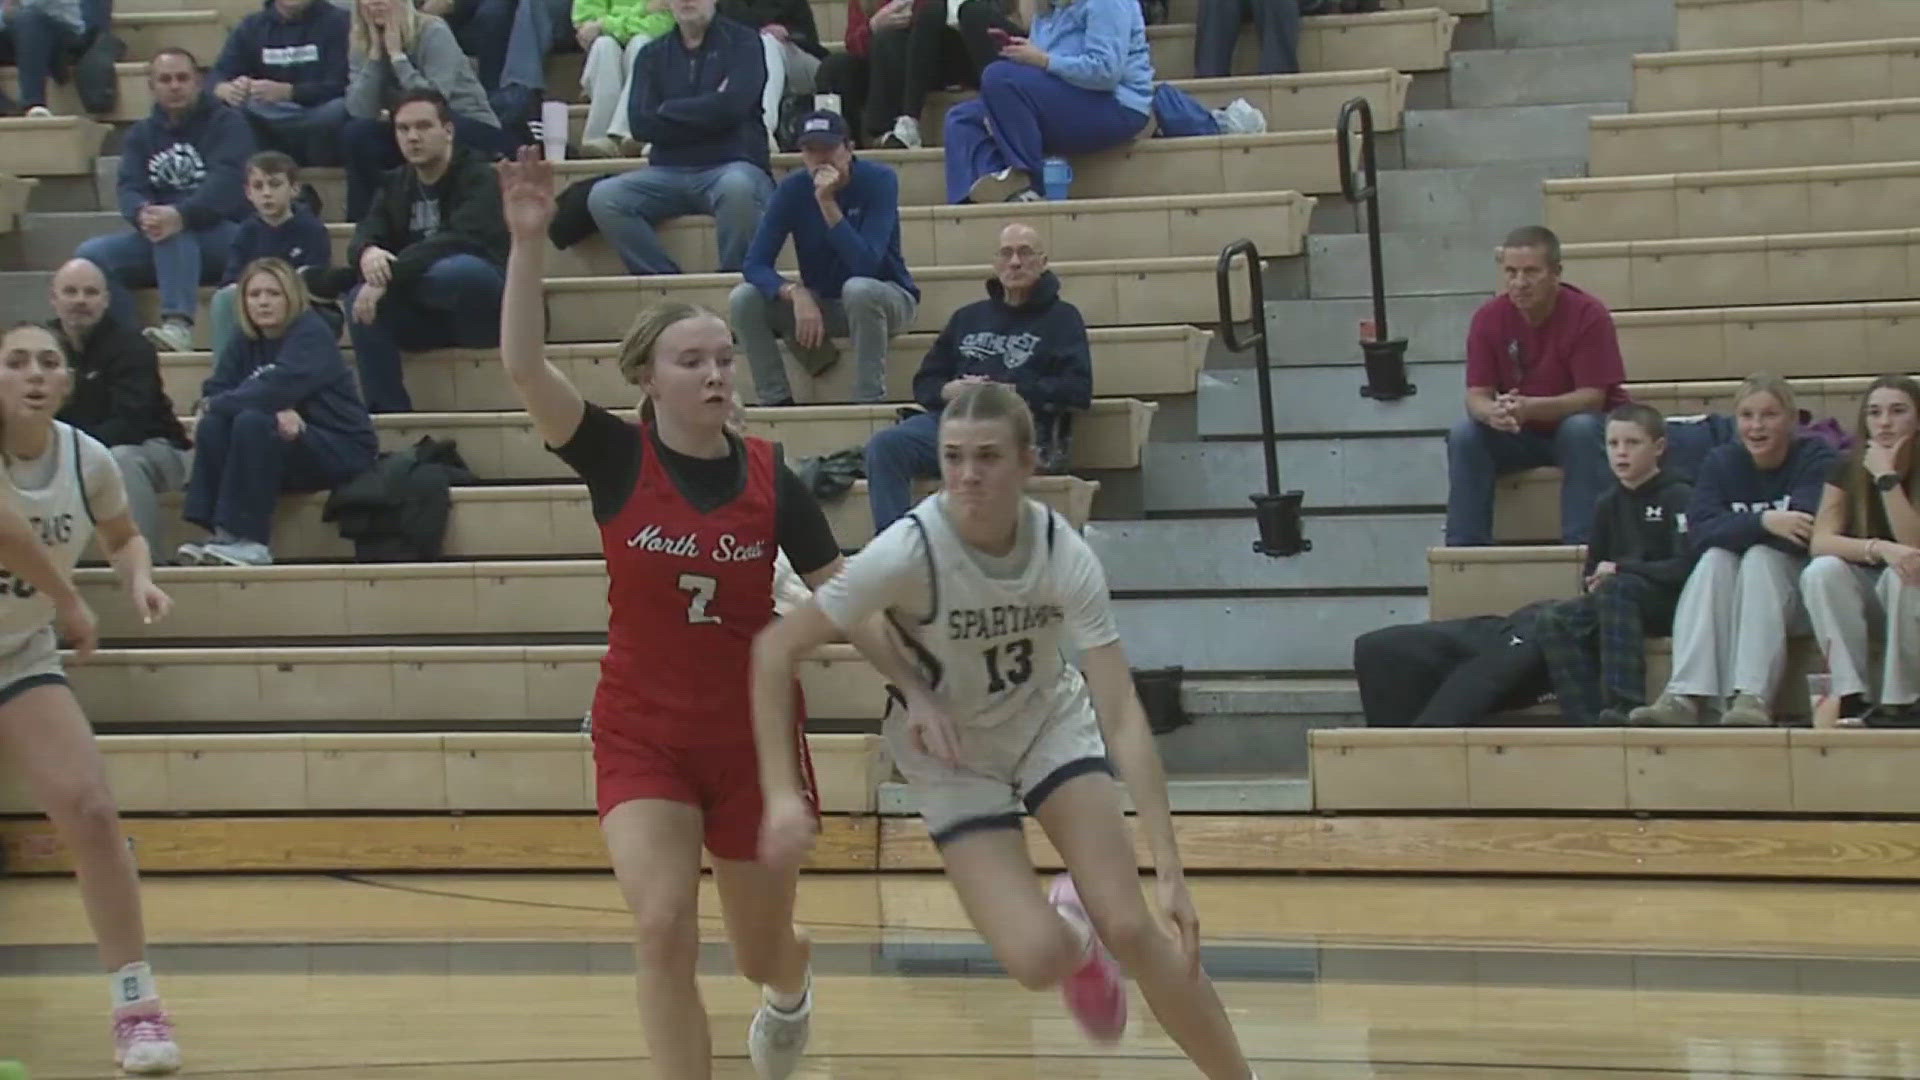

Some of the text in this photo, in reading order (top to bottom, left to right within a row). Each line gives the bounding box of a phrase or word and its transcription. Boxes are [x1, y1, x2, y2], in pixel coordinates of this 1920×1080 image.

[627, 524, 766, 562] North Scot
[982, 638, 1034, 694] 13
